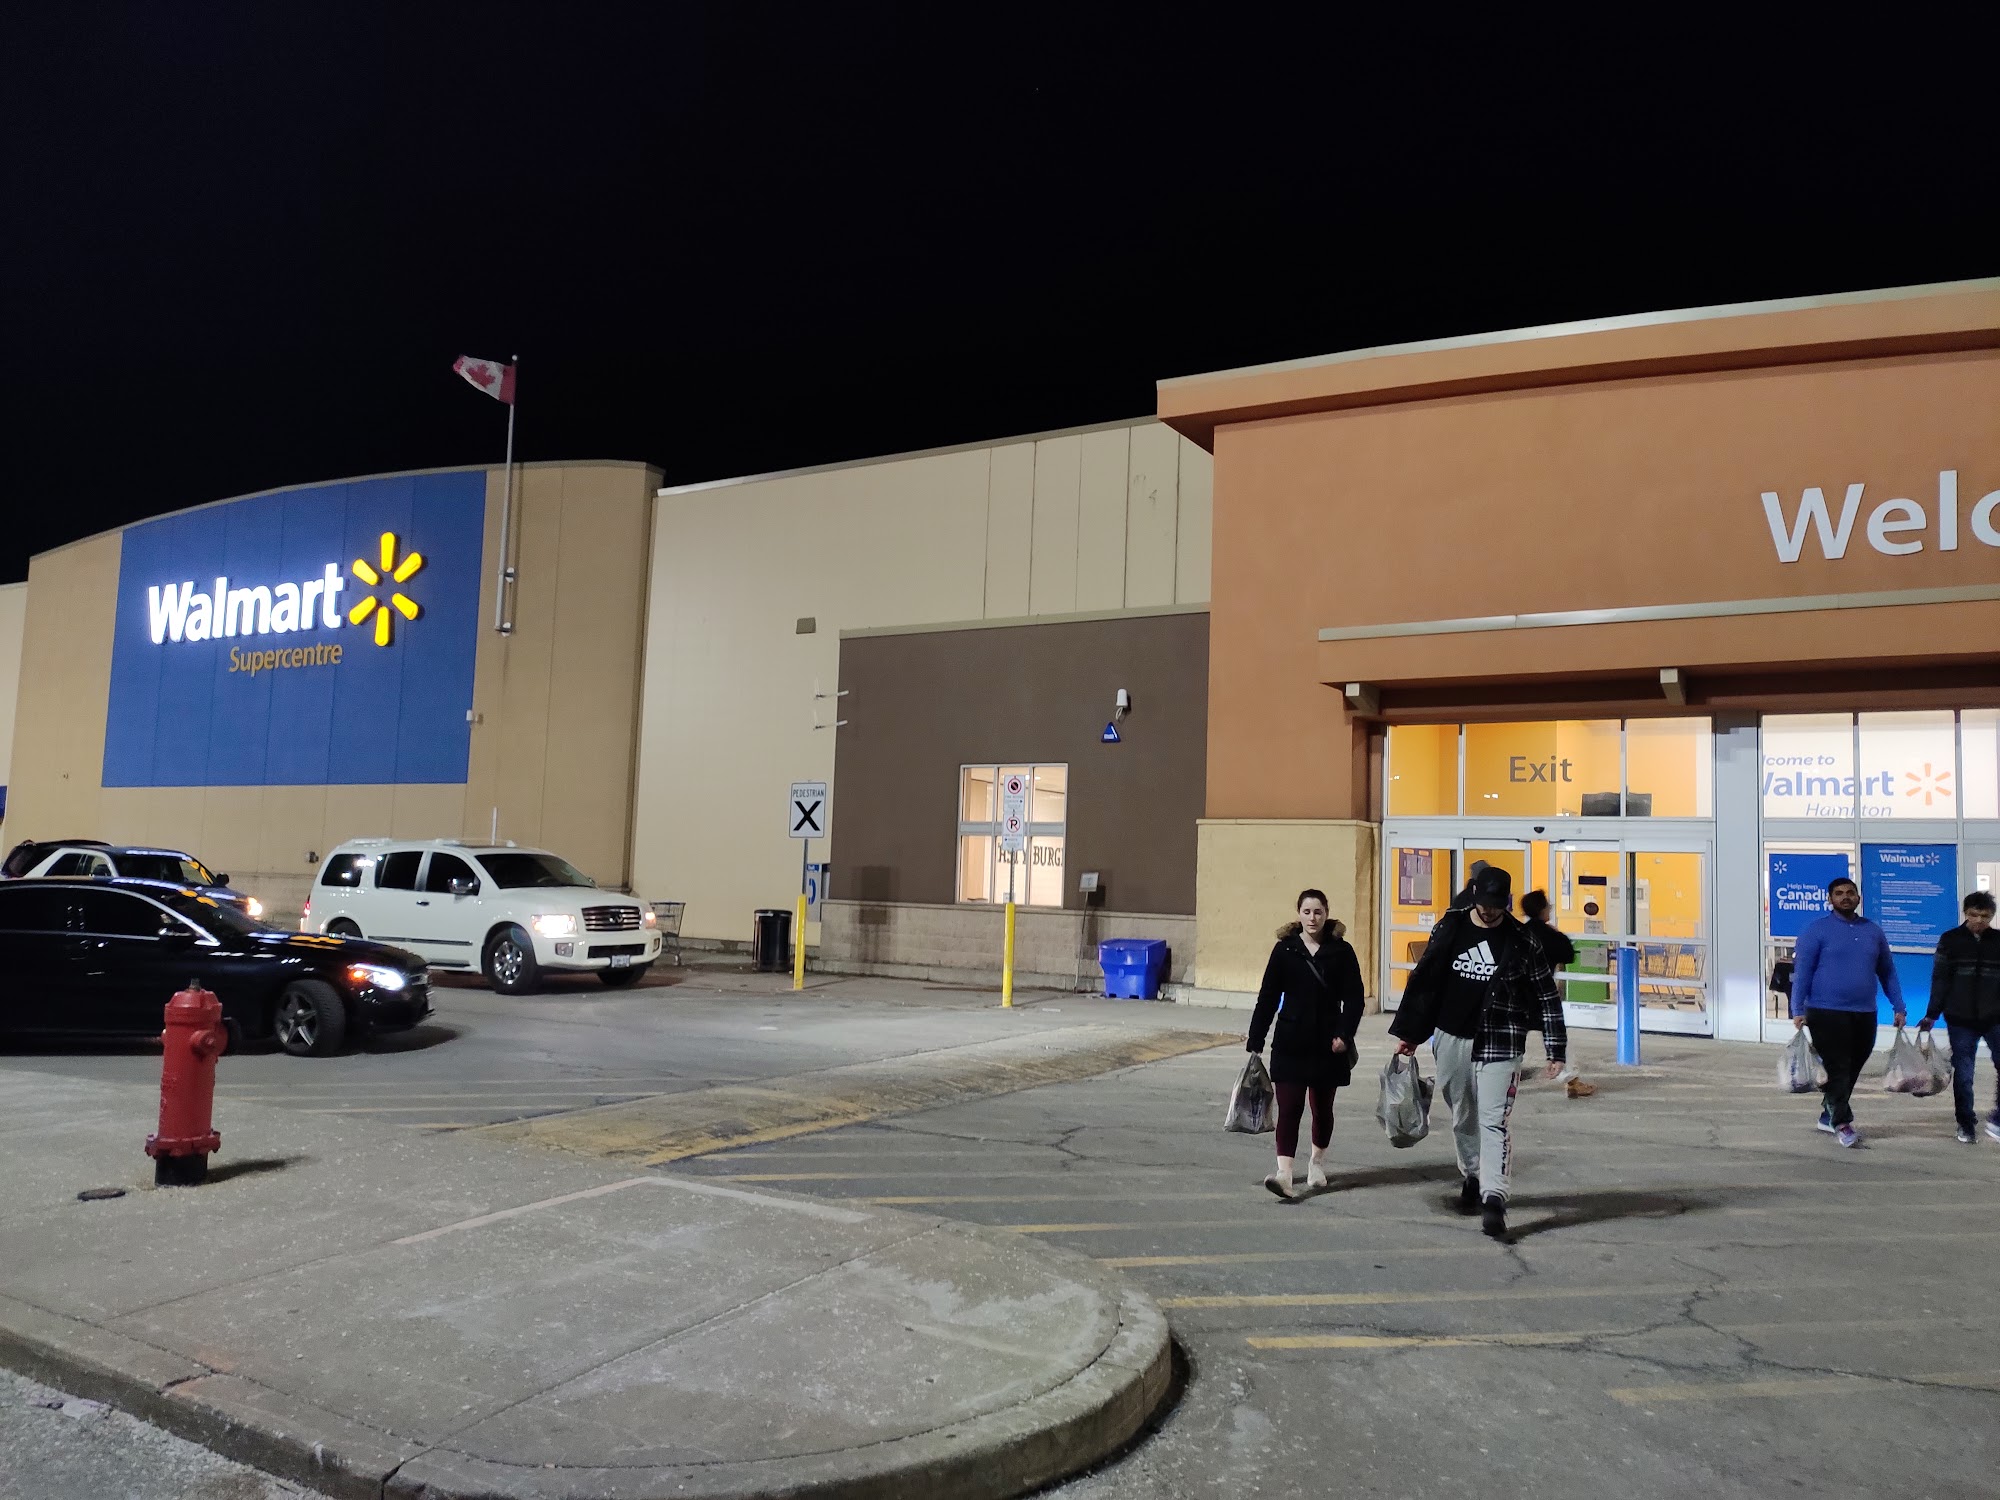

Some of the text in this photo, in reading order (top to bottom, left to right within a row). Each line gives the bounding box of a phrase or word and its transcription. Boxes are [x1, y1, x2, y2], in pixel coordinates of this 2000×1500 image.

[148, 562, 345, 644] Walmart
[229, 643, 343, 677] Supercentre
[1817, 755, 1835, 766] to
[1509, 755, 1572, 782] Exit
[792, 788, 825, 798] PEDESTRIAN
[1033, 845, 1064, 867] BURG
[1880, 853, 1925, 864] Walmart
[1778, 899, 1821, 911] families
[1460, 971, 1491, 981] HOCKEY
